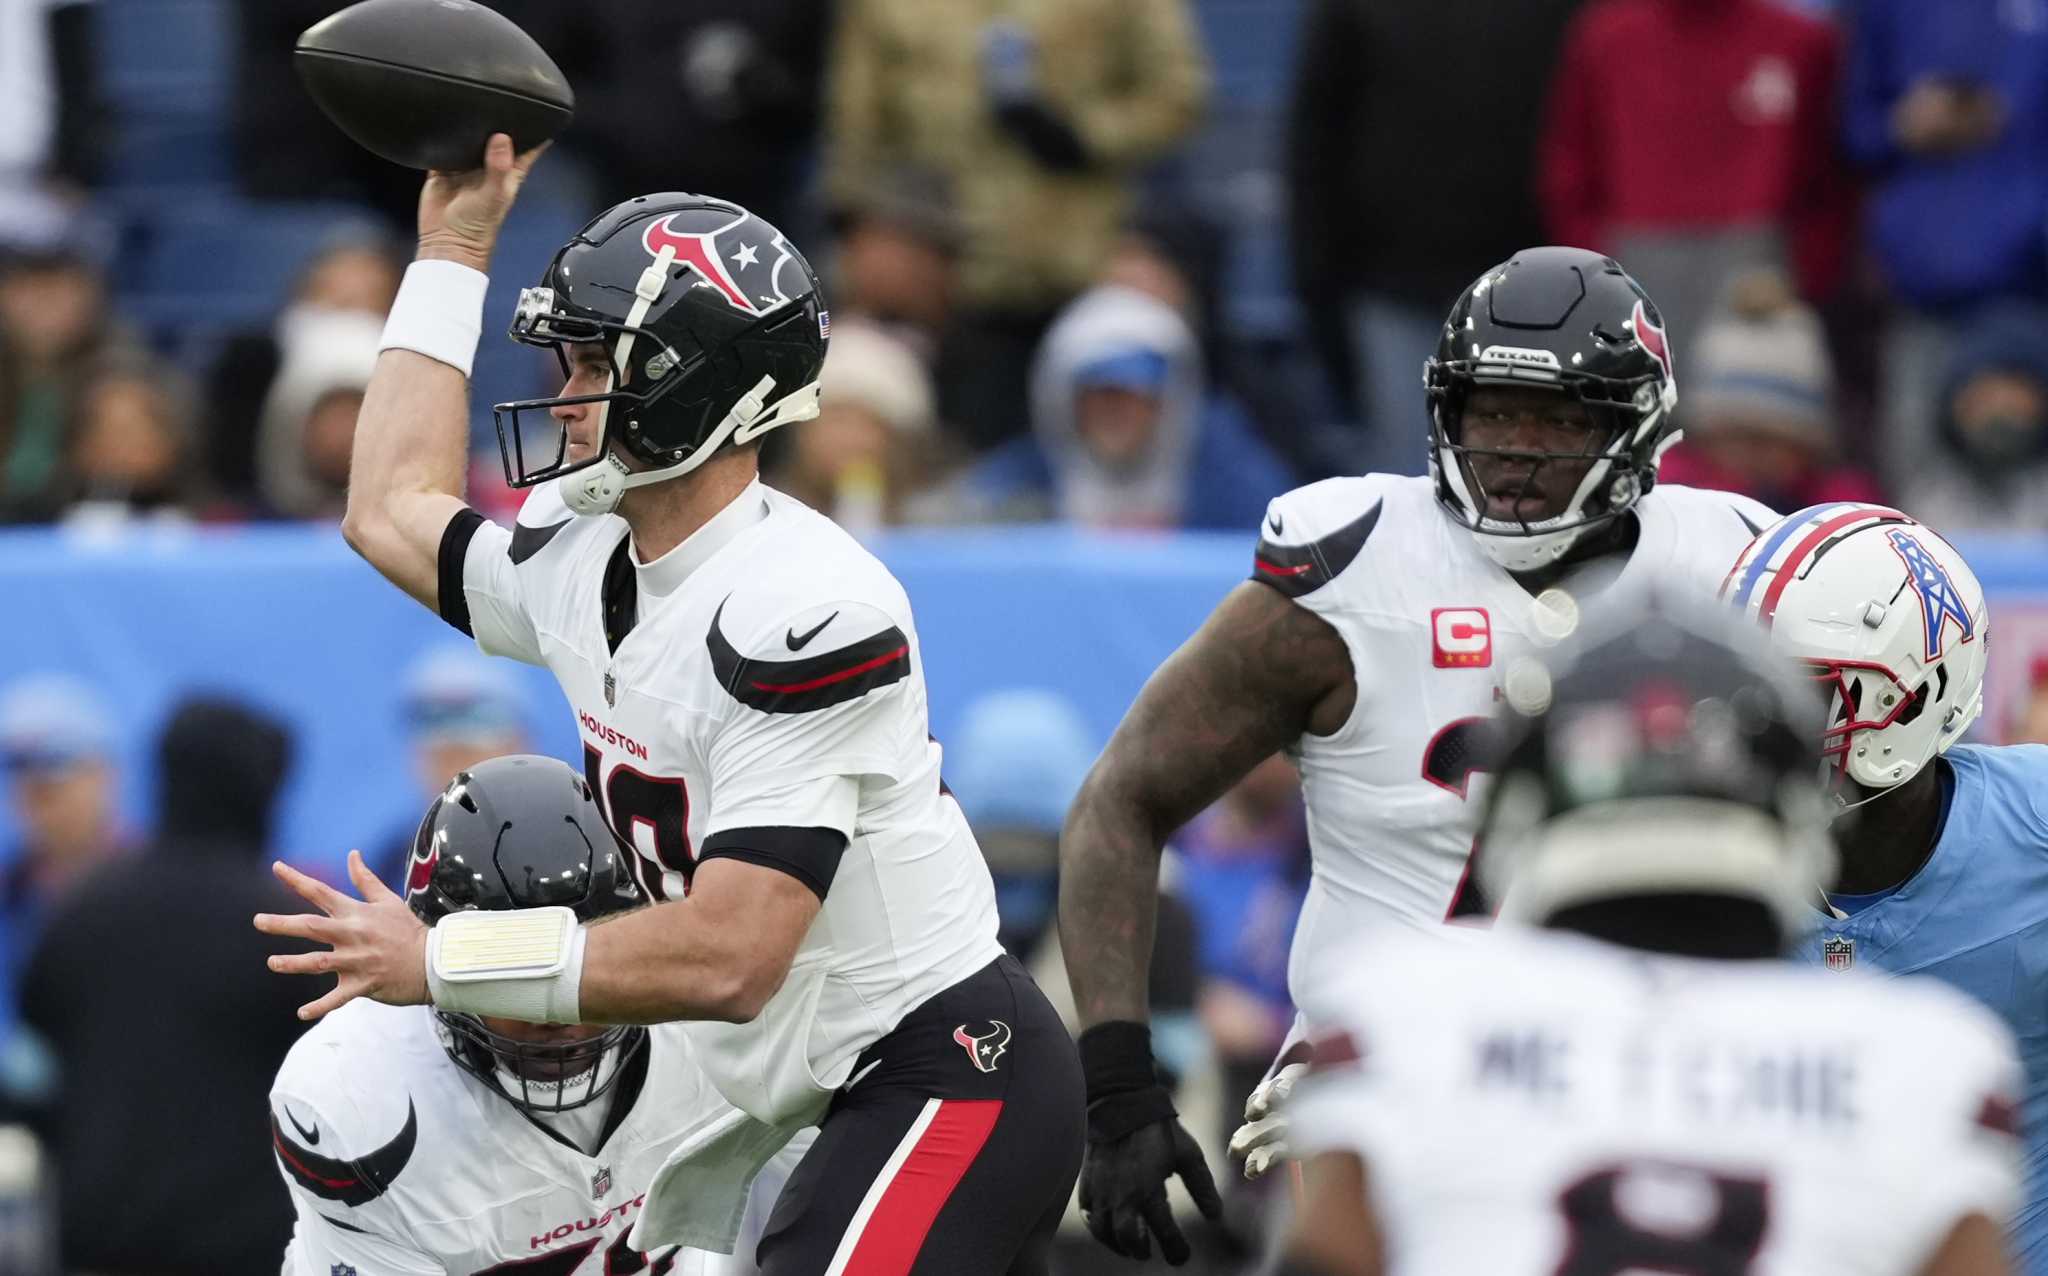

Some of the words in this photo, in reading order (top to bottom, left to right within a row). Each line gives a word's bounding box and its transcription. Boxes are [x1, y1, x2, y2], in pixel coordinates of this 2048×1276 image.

[1488, 351, 1551, 364] TEXANS
[1437, 611, 1489, 653] C
[579, 709, 648, 761] HOUSTON
[530, 1193, 647, 1249] HOUSTO
